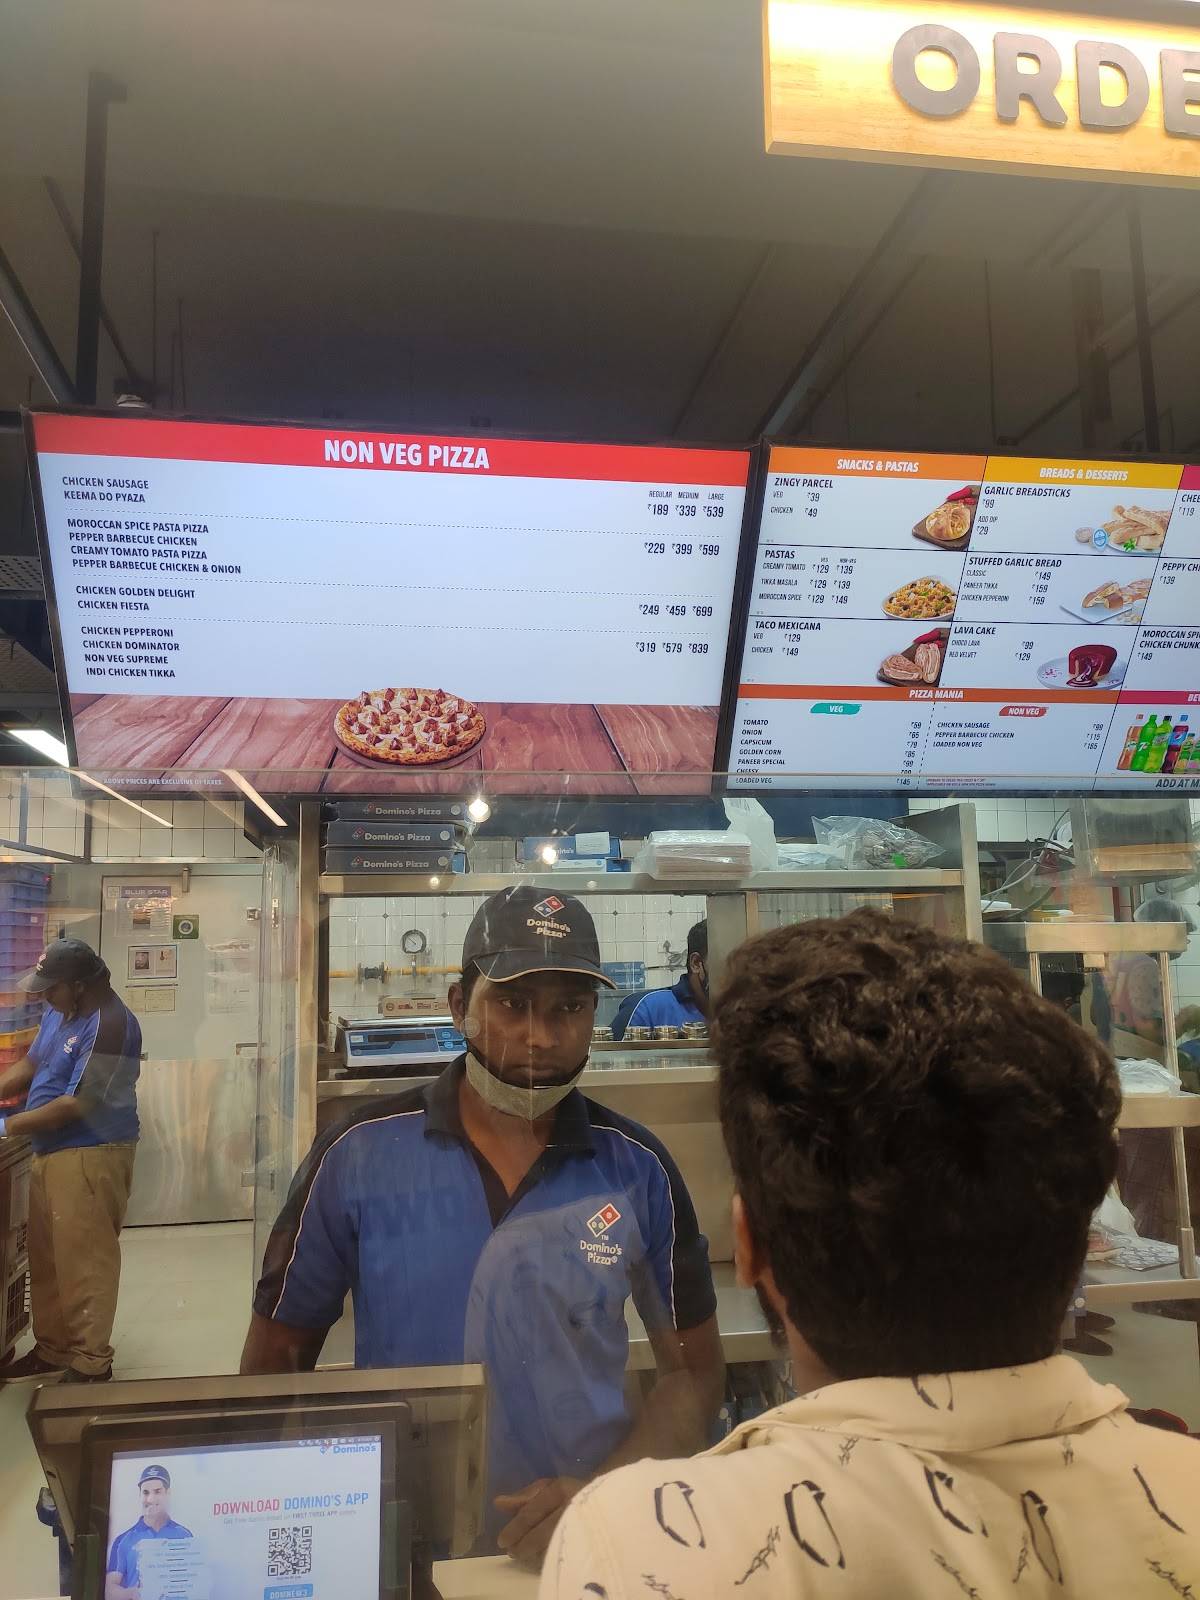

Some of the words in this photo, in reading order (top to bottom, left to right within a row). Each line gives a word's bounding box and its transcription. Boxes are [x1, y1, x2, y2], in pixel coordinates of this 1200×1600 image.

[325, 440, 373, 463] NON
[380, 443, 422, 465] VEG
[429, 445, 489, 468] PIZZA
[837, 459, 873, 470] SNACKS
[876, 460, 882, 471] &
[885, 461, 919, 473] PASTAS
[1040, 468, 1075, 478] BREADS
[1077, 470, 1083, 479] &
[1085, 471, 1128, 481] DESSERTS
[62, 477, 104, 487] CHICKEN
[107, 479, 149, 489] SAUSAGE
[775, 478, 801, 487] ZINGY
[803, 479, 833, 488] PARCEL
[64, 491, 97, 500] KEEMA
[99, 492, 112, 501] DO
[116, 493, 145, 502] PYAZA
[984, 487, 1014, 496] GARLIC
[1016, 488, 1070, 497] BREADSTICKS
[68, 519, 122, 529] MOROCCAN
[125, 521, 151, 530] SPICE
[153, 522, 180, 532] PASTA
[183, 524, 208, 533] PIZZA
[69, 533, 104, 542] PEPPER
[107, 534, 155, 544] BARBECUE
[157, 536, 197, 545] CHICKEN
[71, 546, 109, 556] CREAMY
[111, 547, 149, 557] TOMATO
[152, 549, 179, 558] PASTA
[182, 550, 207, 559] PIZZA
[765, 550, 795, 559] PASTAS
[72, 559, 107, 569] PEPPER
[110, 560, 157, 571] BARBECUE
[159, 562, 199, 572] CHICKEN
[202, 564, 208, 572] &
[211, 565, 241, 573] ONION
[969, 557, 1003, 566] STUFFED
[1004, 559, 1034, 567] GARLIC
[1035, 559, 1061, 567] BREAD
[1162, 563, 1186, 571] PEPPY
[76, 586, 116, 595] CHICKEN
[118, 587, 155, 597] GOLDEN
[158, 589, 195, 598] DELIGHT
[78, 601, 118, 610] CHICKEN
[120, 602, 149, 610] FIESTA
[755, 621, 776, 629] TACO
[778, 622, 821, 630] MEXICANA
[81, 627, 120, 636] CHICKEN
[123, 628, 173, 637] PEPPERONI
[976, 627, 996, 635] CAKE
[83, 640, 122, 649] CHICKEN
[125, 642, 179, 651] DOMINATOR
[85, 654, 104, 662] NON
[107, 655, 124, 663] VEG
[127, 655, 168, 664] SUPREME
[86, 667, 106, 676] INDI
[109, 668, 147, 677] CHICKEN
[149, 669, 175, 677] TIKKA
[909, 690, 933, 698] PIZZA
[934, 690, 963, 699] MANIA
[1156, 779, 1176, 787] ADD
[1177, 779, 1190, 787] AT
[375, 807, 415, 816] Domino's
[364, 832, 405, 841] Domino's
[407, 833, 430, 841] Pizza
[363, 860, 403, 868] Domino's
[405, 860, 429, 868] Pizza
[527, 919, 571, 933] Domino's
[580, 1240, 622, 1255] Domino's
[333, 1444, 376, 1454] Domino's
[214, 1499, 280, 1516] DOWNLOAD
[284, 1494, 341, 1510] DOMINO'S
[346, 1492, 368, 1505] APP
